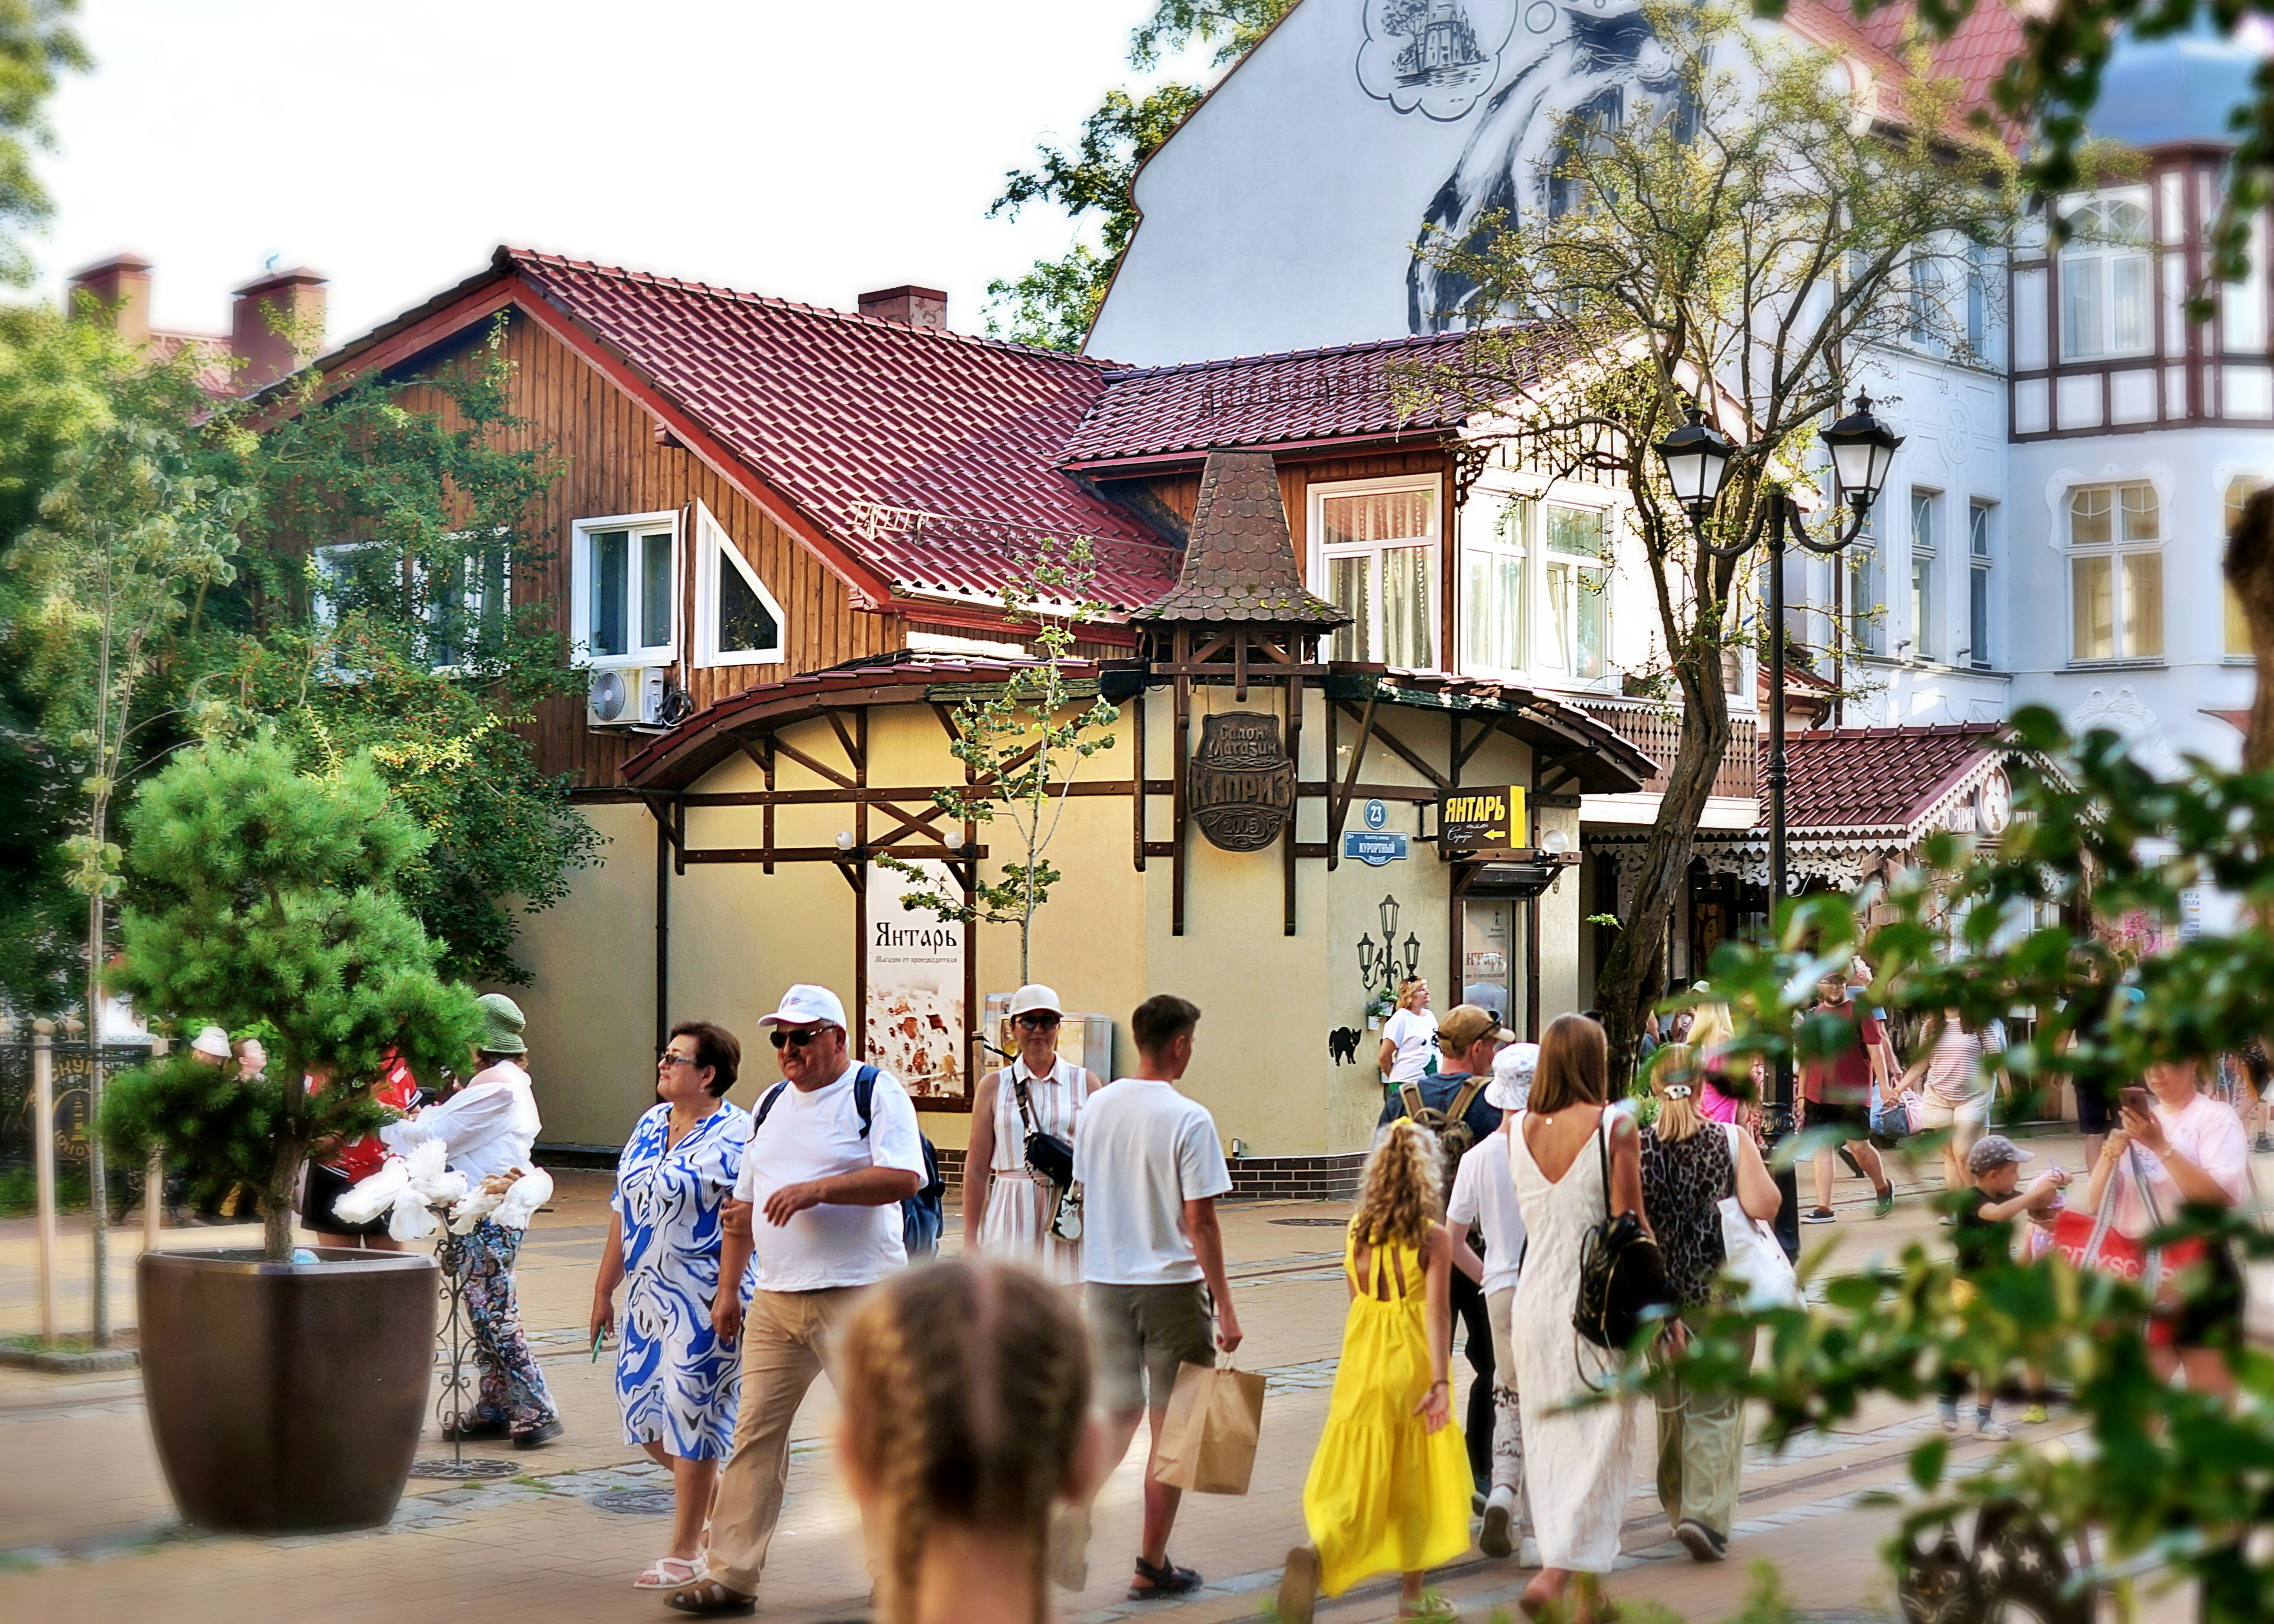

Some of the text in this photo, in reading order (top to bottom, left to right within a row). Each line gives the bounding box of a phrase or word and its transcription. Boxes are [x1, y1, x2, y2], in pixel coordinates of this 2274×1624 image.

[1221, 725, 1265, 740] Салон
[1208, 740, 1276, 759] Магазин
[1191, 767, 1291, 810] КАПРИЗ
[1370, 806, 1382, 822] 23
[1444, 796, 1506, 823] ЯНТАРЬ
[1223, 818, 1259, 834] 2005
[1358, 841, 1395, 853] КУРОРТНЫЙ
[875, 922, 958, 955] Янтарь
